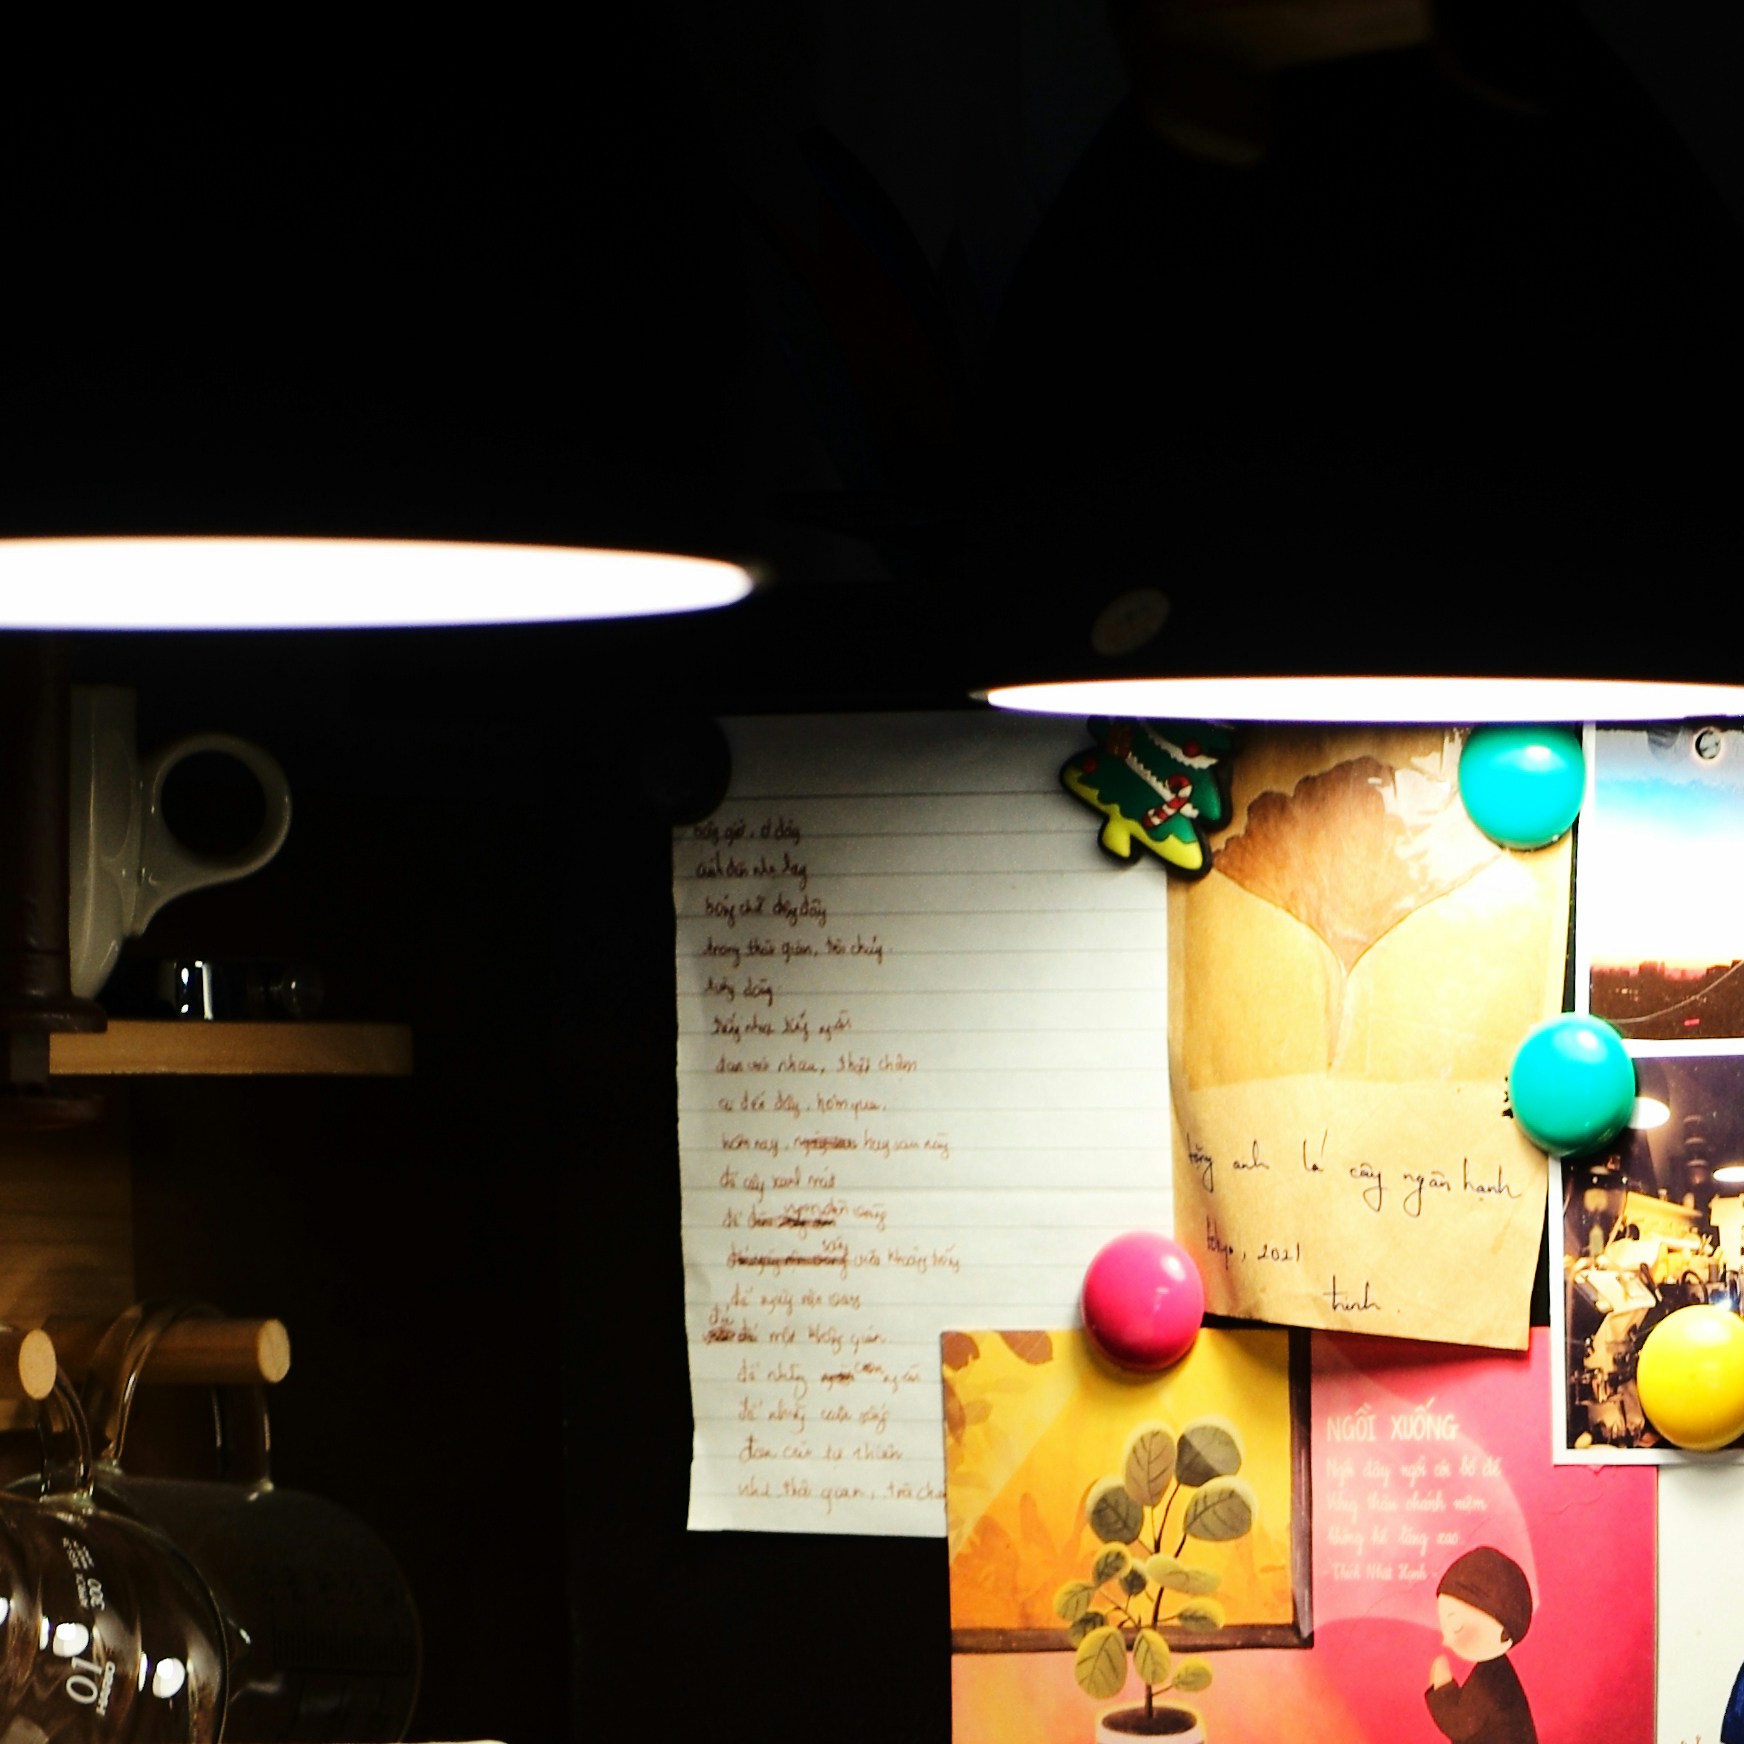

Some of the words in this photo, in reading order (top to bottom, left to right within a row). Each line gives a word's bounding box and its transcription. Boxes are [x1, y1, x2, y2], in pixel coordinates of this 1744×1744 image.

[1232, 1139, 1270, 1170] anh
[1326, 1402, 1377, 1442] NGỒI
[1390, 1397, 1460, 1442] XUỐNG
